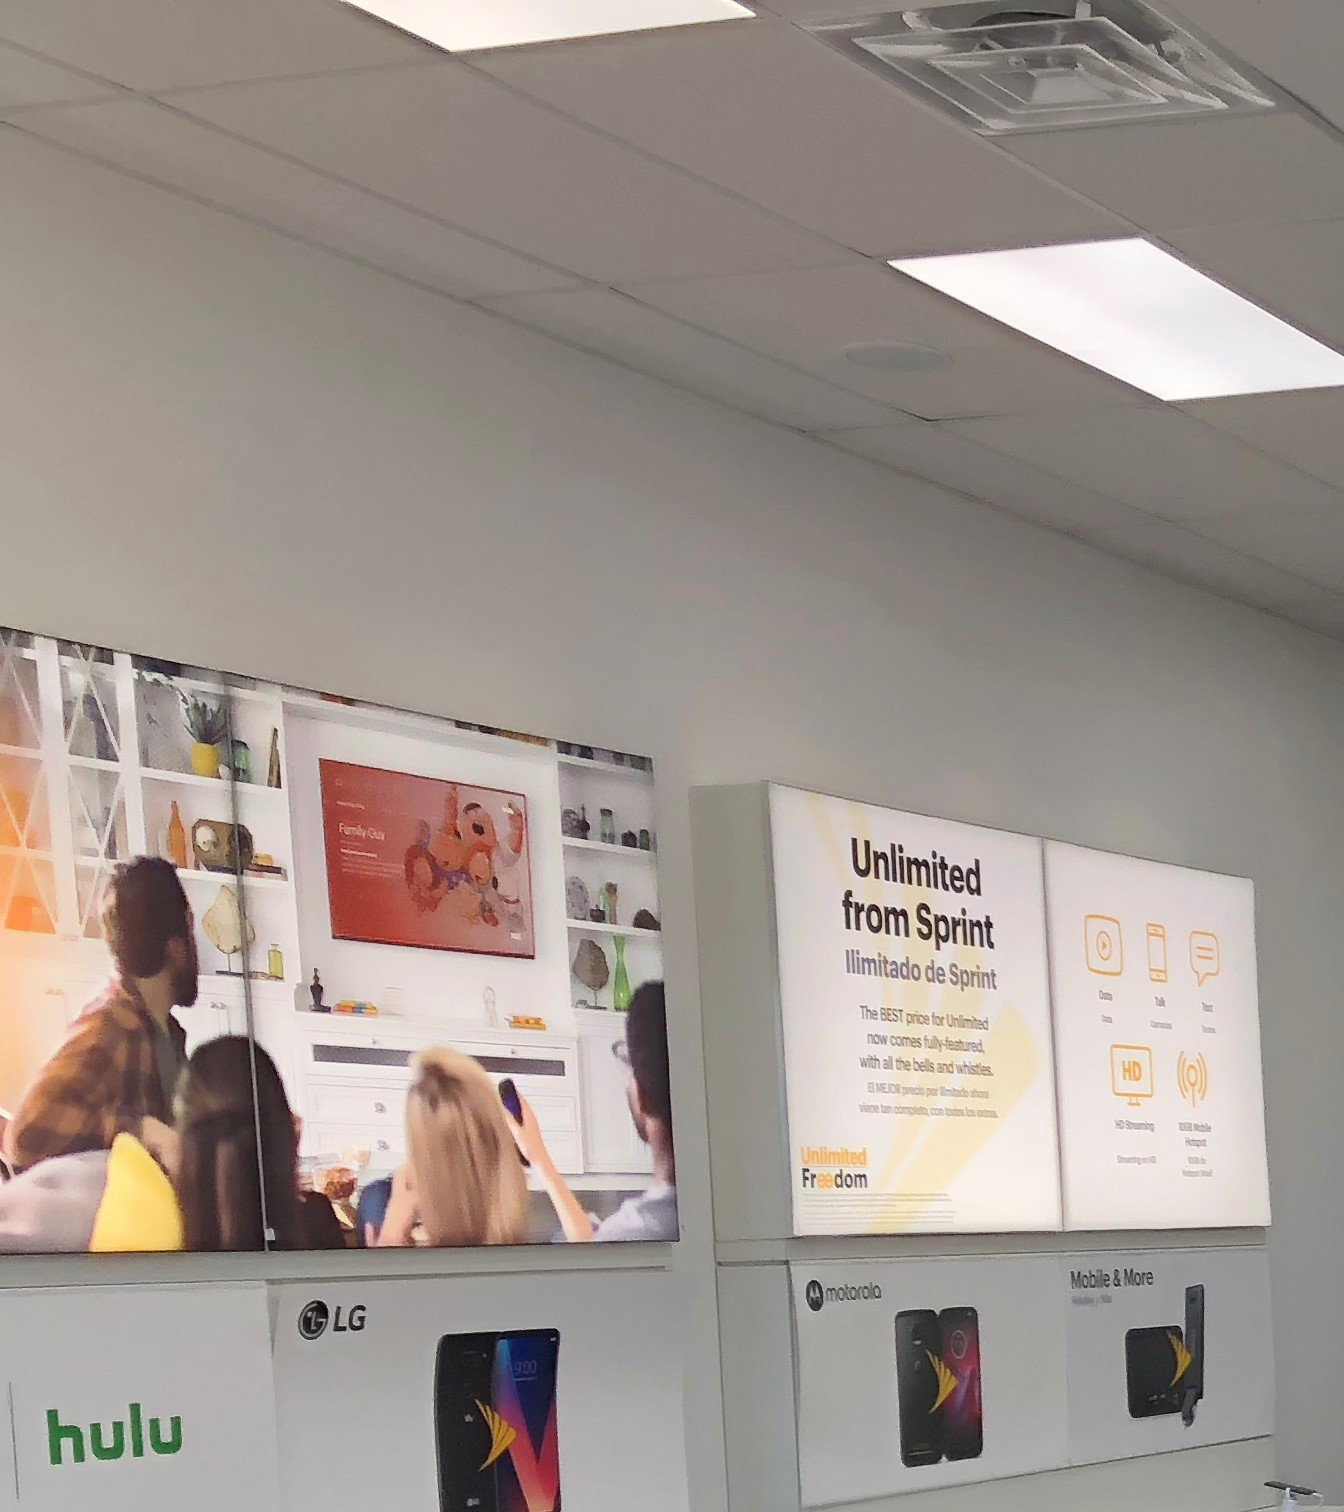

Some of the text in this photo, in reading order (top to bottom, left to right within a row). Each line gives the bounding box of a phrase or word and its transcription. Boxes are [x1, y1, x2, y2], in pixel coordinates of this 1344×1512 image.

[851, 837, 982, 896] Unlimited
[842, 889, 995, 950] from Sprint
[845, 949, 998, 992] Ilimitado de Sprint
[859, 1005, 989, 1030] The BEST price for Unlimited
[867, 1033, 888, 1045] now
[890, 1035, 922, 1048] comes
[859, 1054, 994, 1076] with all the bells and whistles.
[1122, 1060, 1142, 1081] HD
[800, 1146, 868, 1165] Unlimited
[801, 1168, 868, 1189] Freedom
[1070, 1268, 1154, 1289] Mobile & More
[826, 1282, 882, 1301] motorola
[332, 1304, 367, 1332] LG
[46, 1402, 182, 1466] hulu
